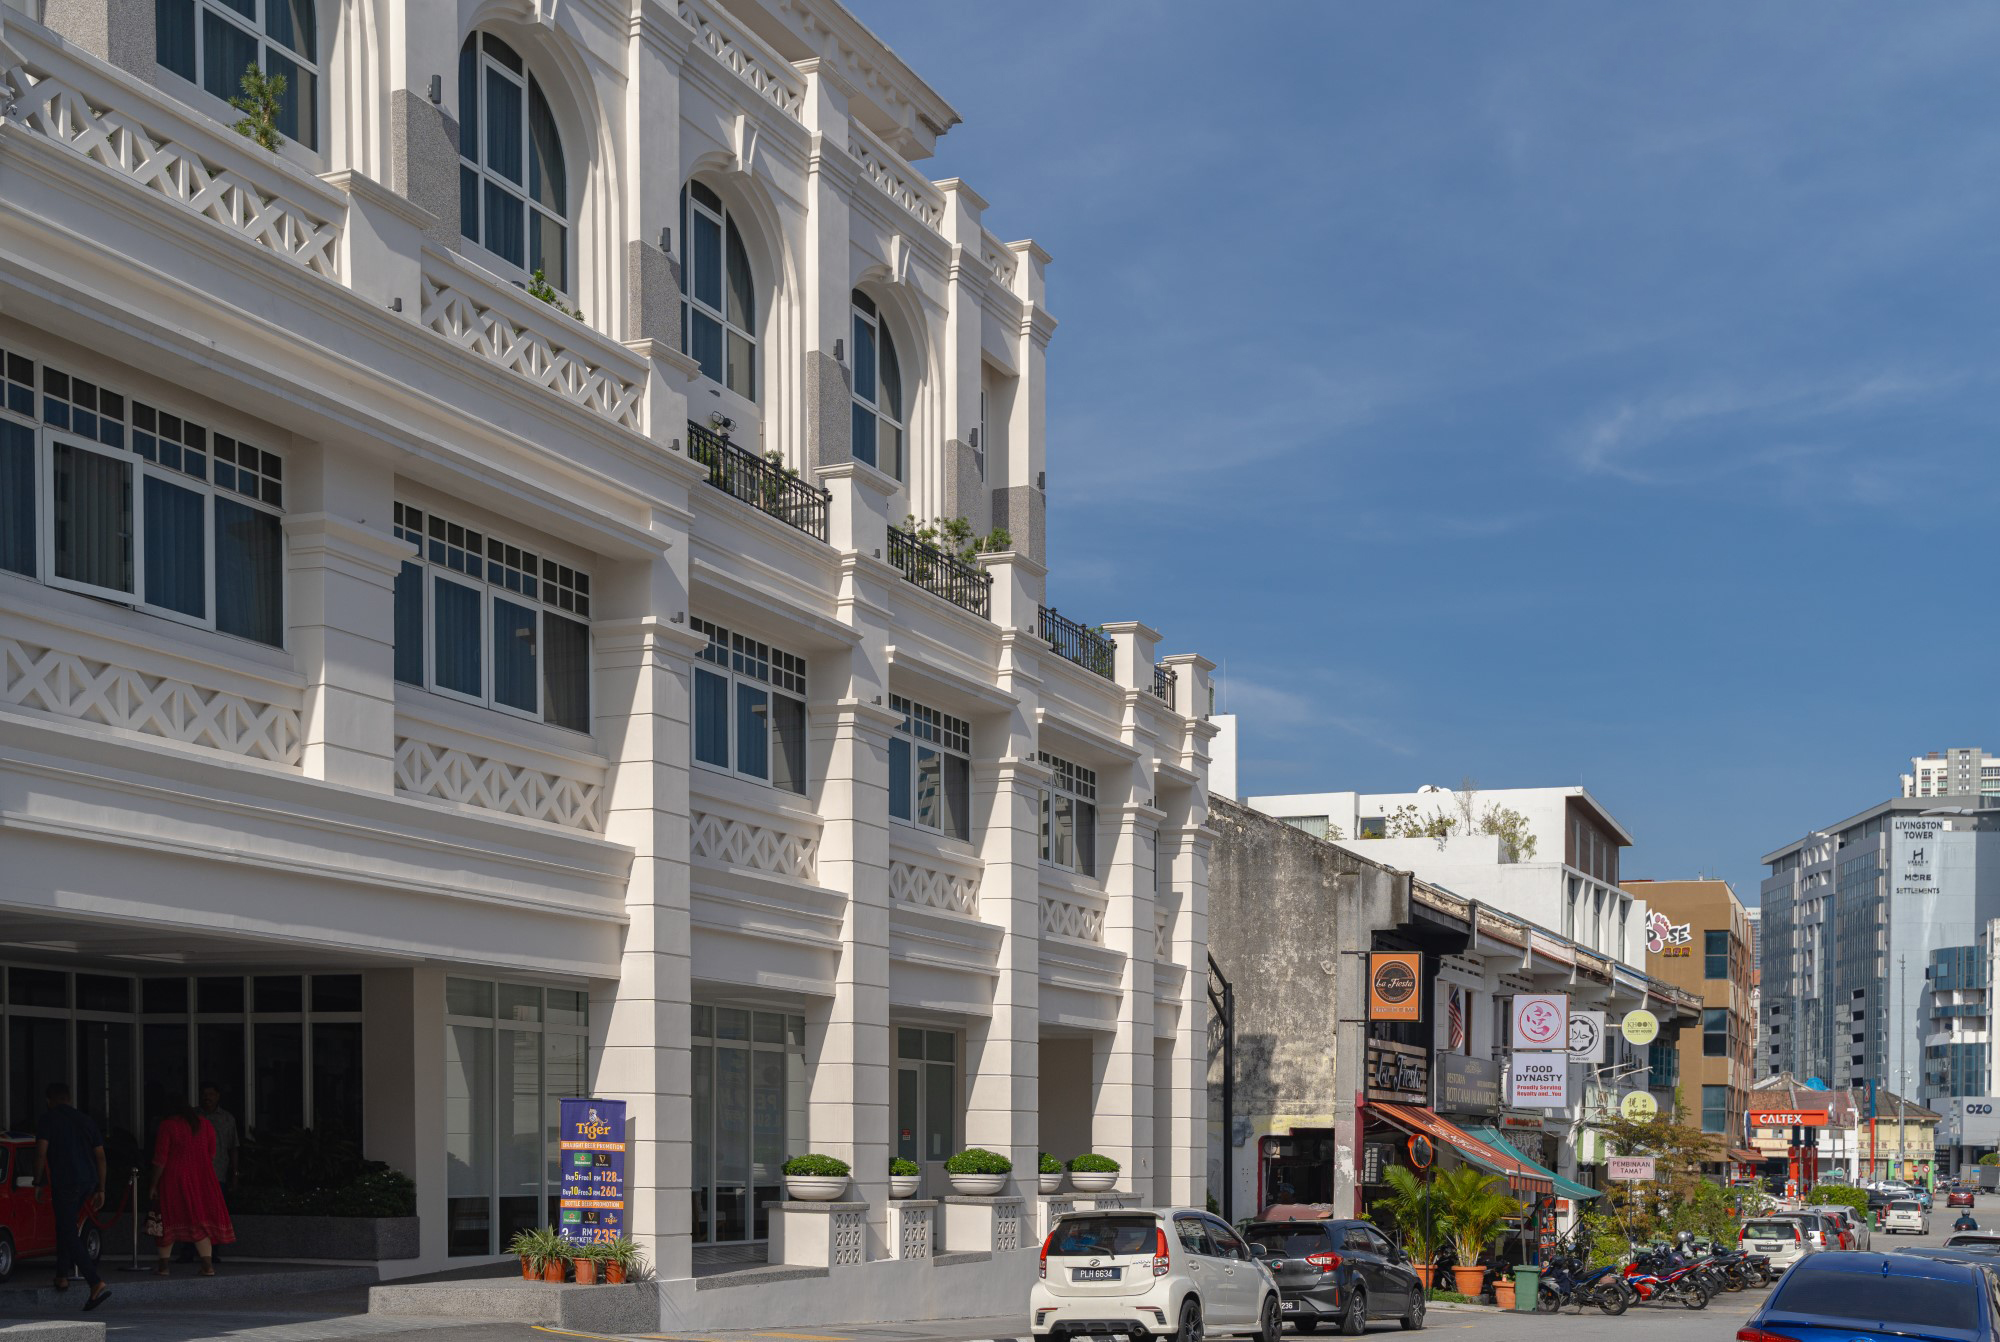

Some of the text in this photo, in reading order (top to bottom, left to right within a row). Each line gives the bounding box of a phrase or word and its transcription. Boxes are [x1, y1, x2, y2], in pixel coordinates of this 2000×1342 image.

[1376, 978, 1413, 988] La Fiesta
[1394, 1052, 1422, 1092] Fiesta
[1447, 1073, 1465, 1085] RESTORAN
[1966, 1104, 1992, 1114] OZO
[1760, 1114, 1803, 1124] CALTEX
[576, 1122, 611, 1140] Tiger
[602, 1171, 616, 1182] 128
[601, 1186, 616, 1196] 260
[594, 1228, 616, 1244] 235
[1080, 1270, 1094, 1278] PLH
